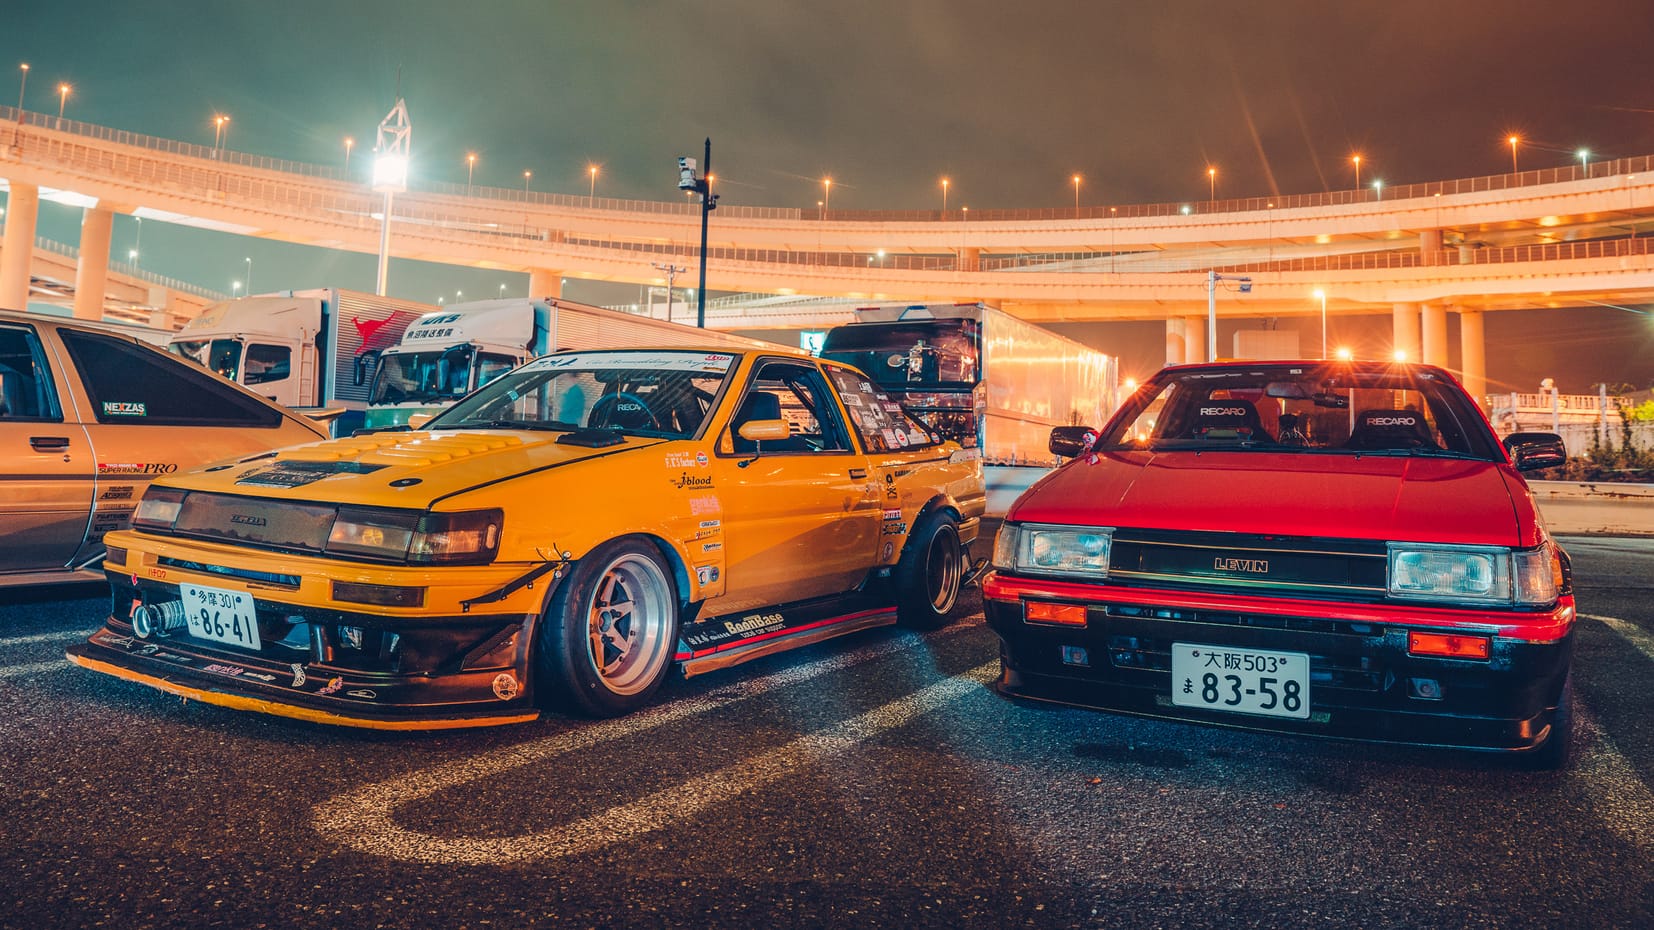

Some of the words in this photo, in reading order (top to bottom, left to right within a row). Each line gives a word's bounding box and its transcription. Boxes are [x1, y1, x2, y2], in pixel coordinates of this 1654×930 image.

[104, 402, 145, 412] NEXZAS
[617, 403, 641, 411] RECA
[1200, 407, 1246, 416] RECARO
[1366, 417, 1416, 426] RECARO
[144, 463, 178, 474] PRO
[1214, 557, 1268, 573] LEVIN
[190, 613, 200, 626] は
[201, 608, 252, 644] 86-41
[1183, 678, 1194, 694] ま
[1202, 672, 1301, 712] 83-58
